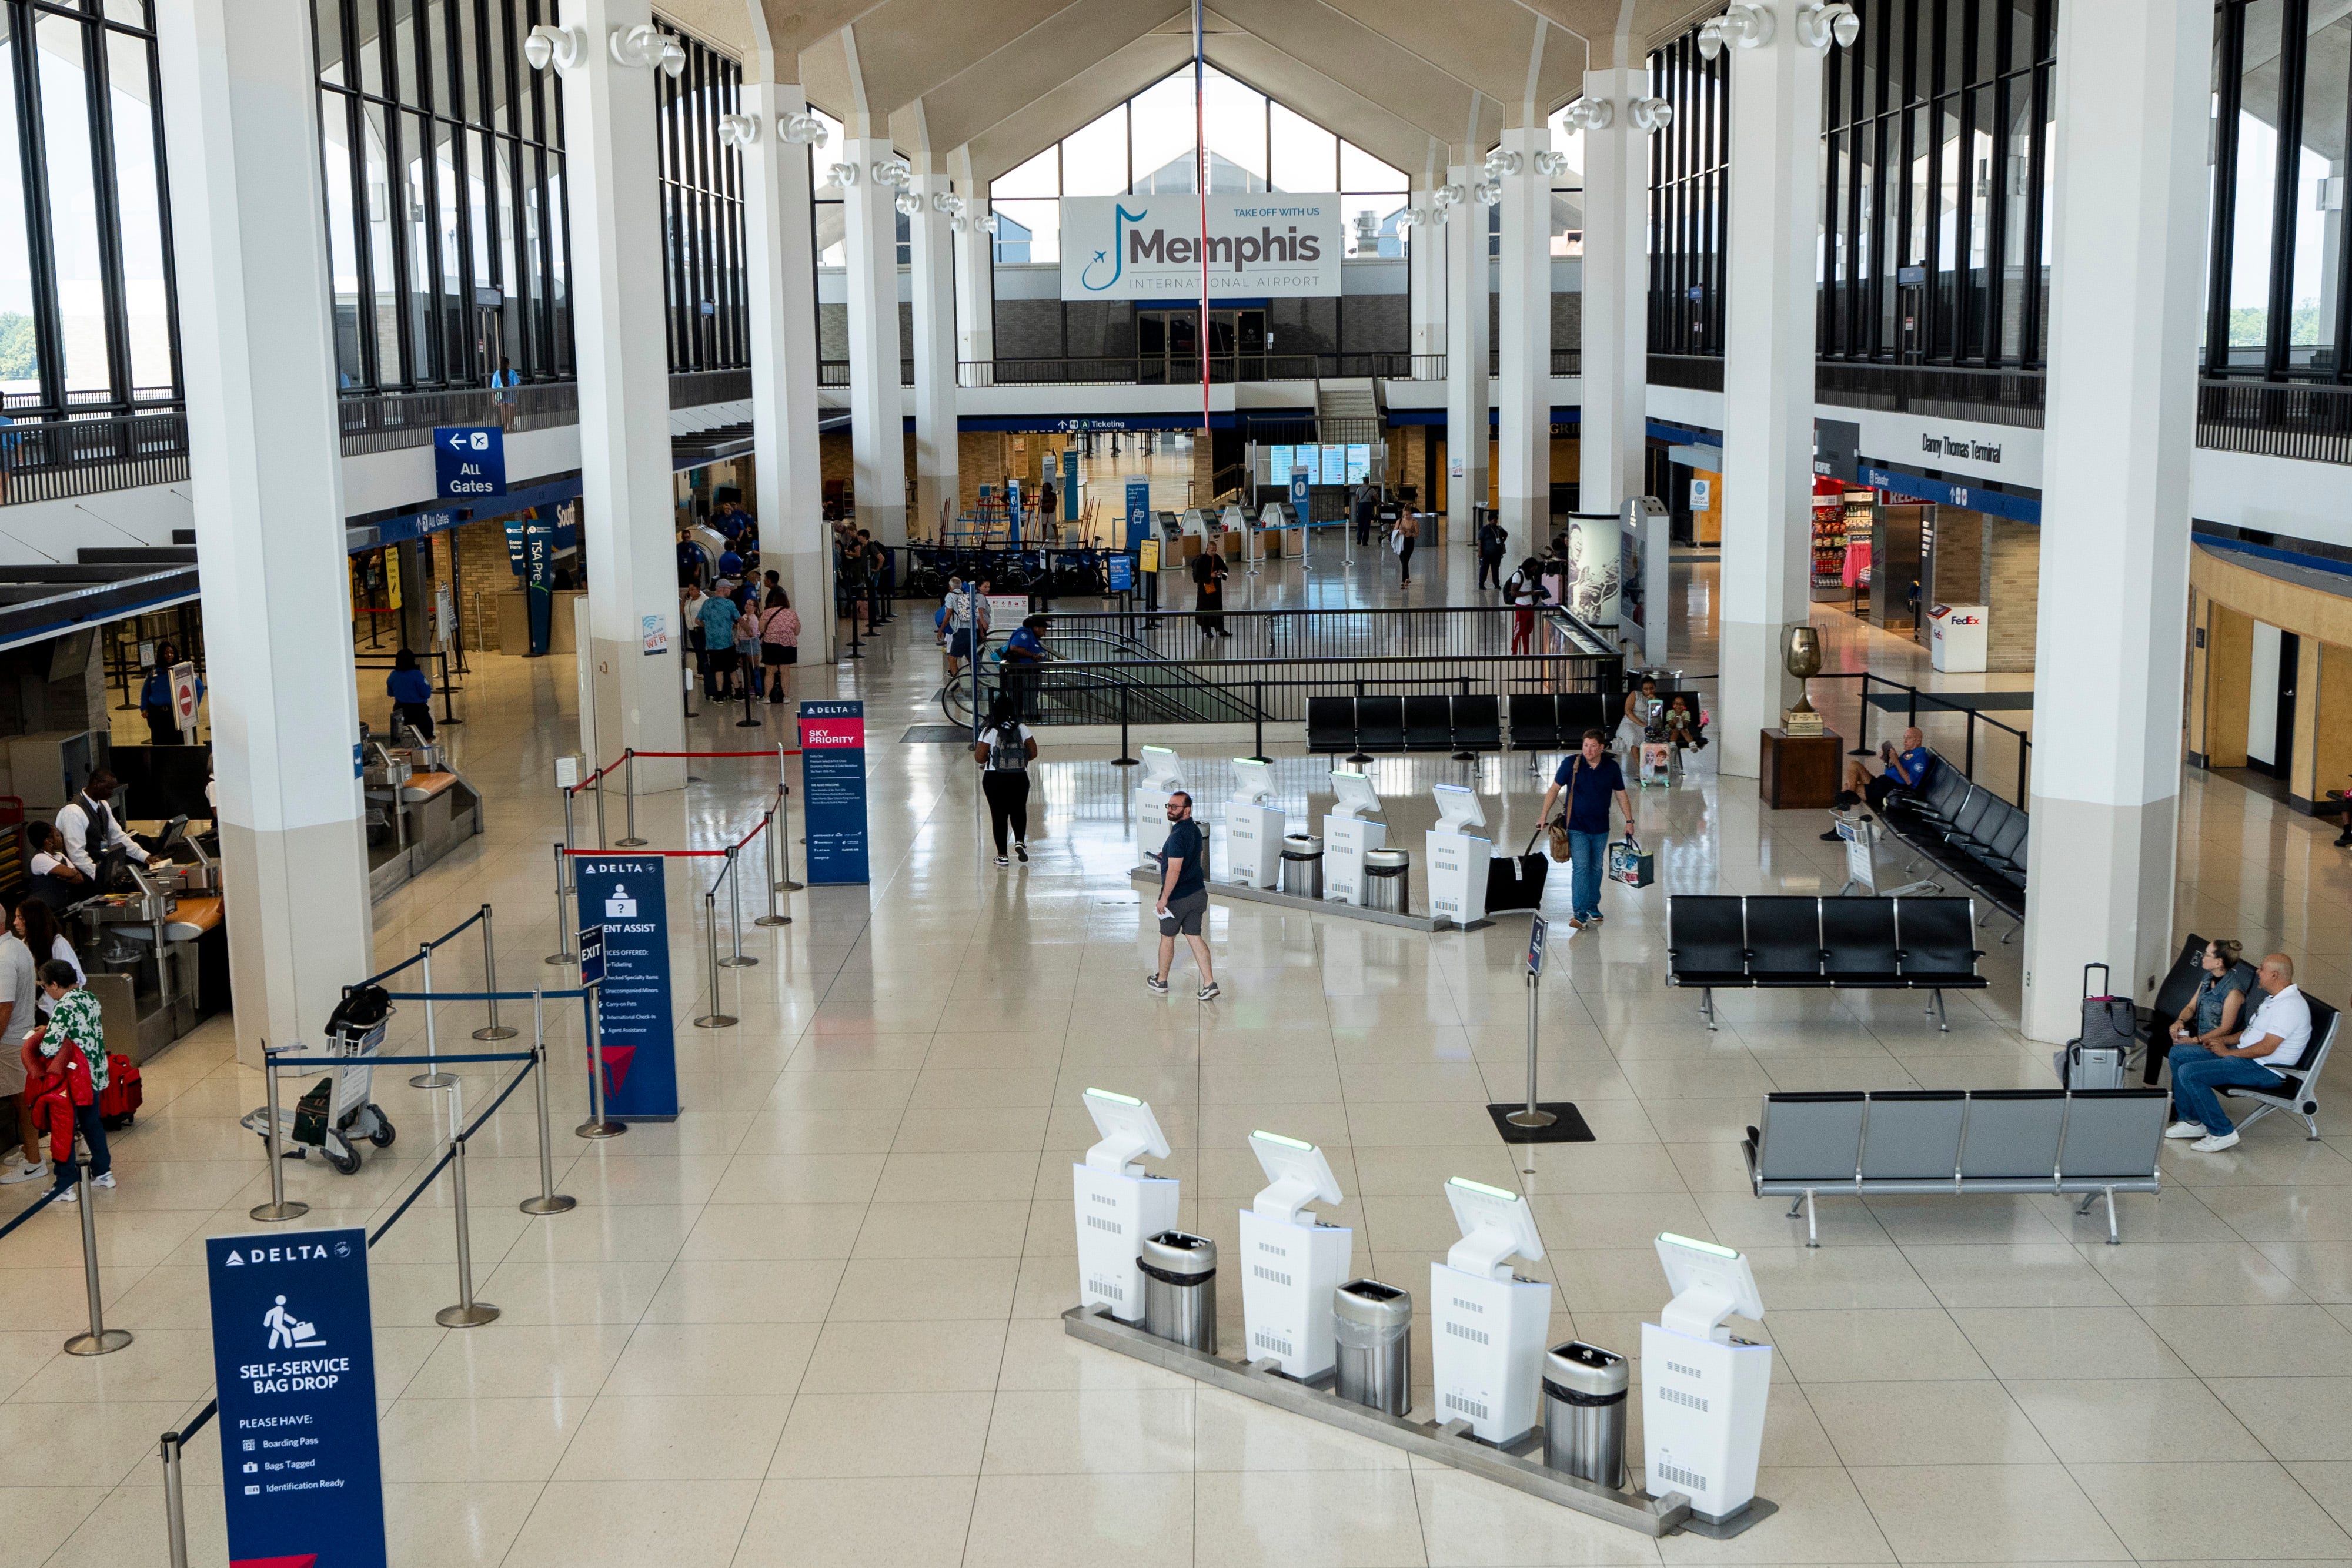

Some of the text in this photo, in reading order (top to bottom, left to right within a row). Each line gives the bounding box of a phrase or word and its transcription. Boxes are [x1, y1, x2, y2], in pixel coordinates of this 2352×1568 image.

[1234, 208, 1320, 217] TAKE OFF WITH US
[1130, 226, 1321, 272] Memphis
[1130, 276, 1319, 289] INTERNATONAL AIRPORT
[1091, 420, 1125, 429] Ticketing
[1922, 433, 2001, 463] Danny Thomas Terminal
[450, 480, 493, 492] Gates
[1298, 484, 1302, 494] 1
[436, 513, 449, 526] Gates
[532, 540, 543, 561] TSA
[1951, 616, 1980, 625] FedEx
[599, 864, 642, 872] DELTA
[604, 924, 656, 932] ENT ASSIST
[582, 944, 601, 961] EXIT
[250, 1245, 328, 1263] DELTA
[240, 1358, 349, 1379] SELF-SERVICE
[253, 1375, 339, 1394] BAG DROP
[239, 1415, 313, 1429] PLEASE HAVE:
[263, 1438, 299, 1448] Boarding
[265, 1459, 315, 1470] Bags Tagged
[266, 1478, 345, 1492] Identification Ready
